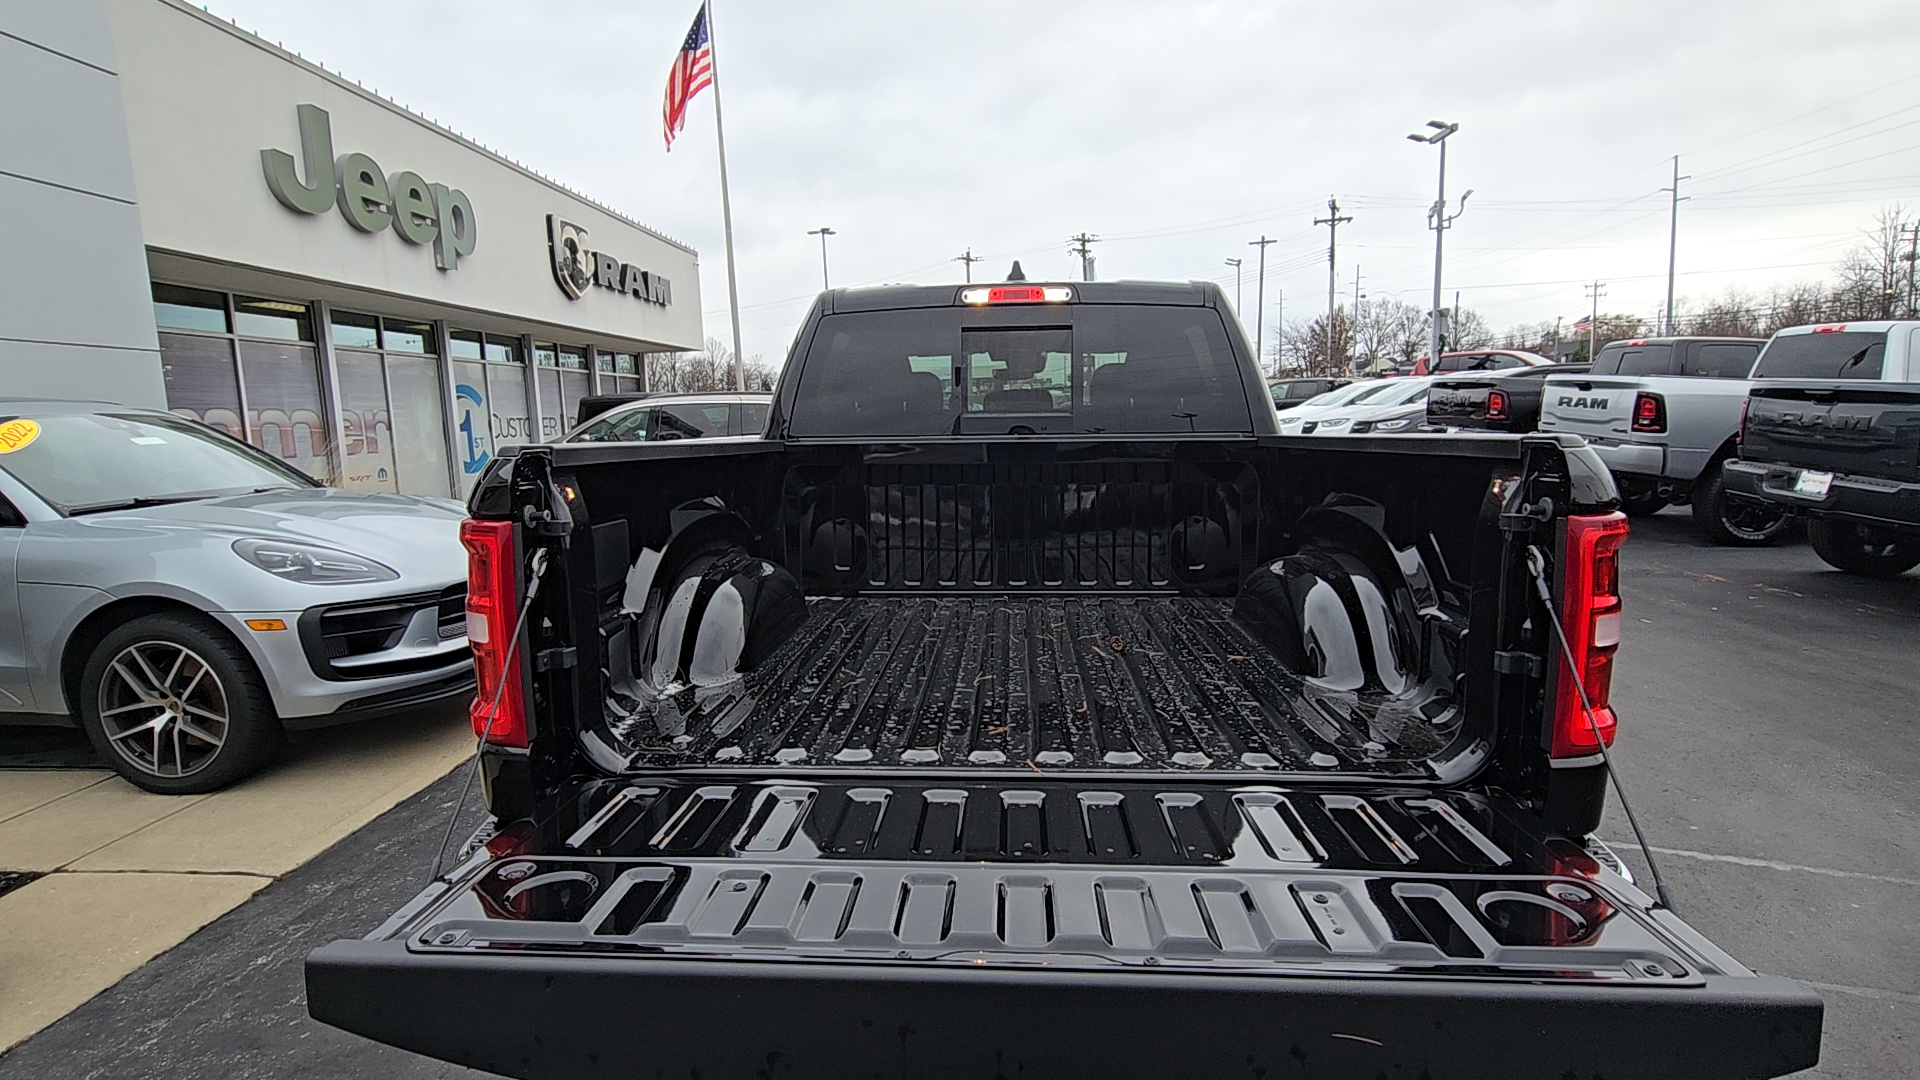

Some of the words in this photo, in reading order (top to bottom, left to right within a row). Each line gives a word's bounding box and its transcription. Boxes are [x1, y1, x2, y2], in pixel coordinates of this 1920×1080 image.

[260, 104, 477, 271] Jeep
[591, 251, 672, 307] RAM
[1557, 396, 1609, 410] RAM
[1775, 411, 1874, 431] RAM
[0, 423, 33, 448] 2022
